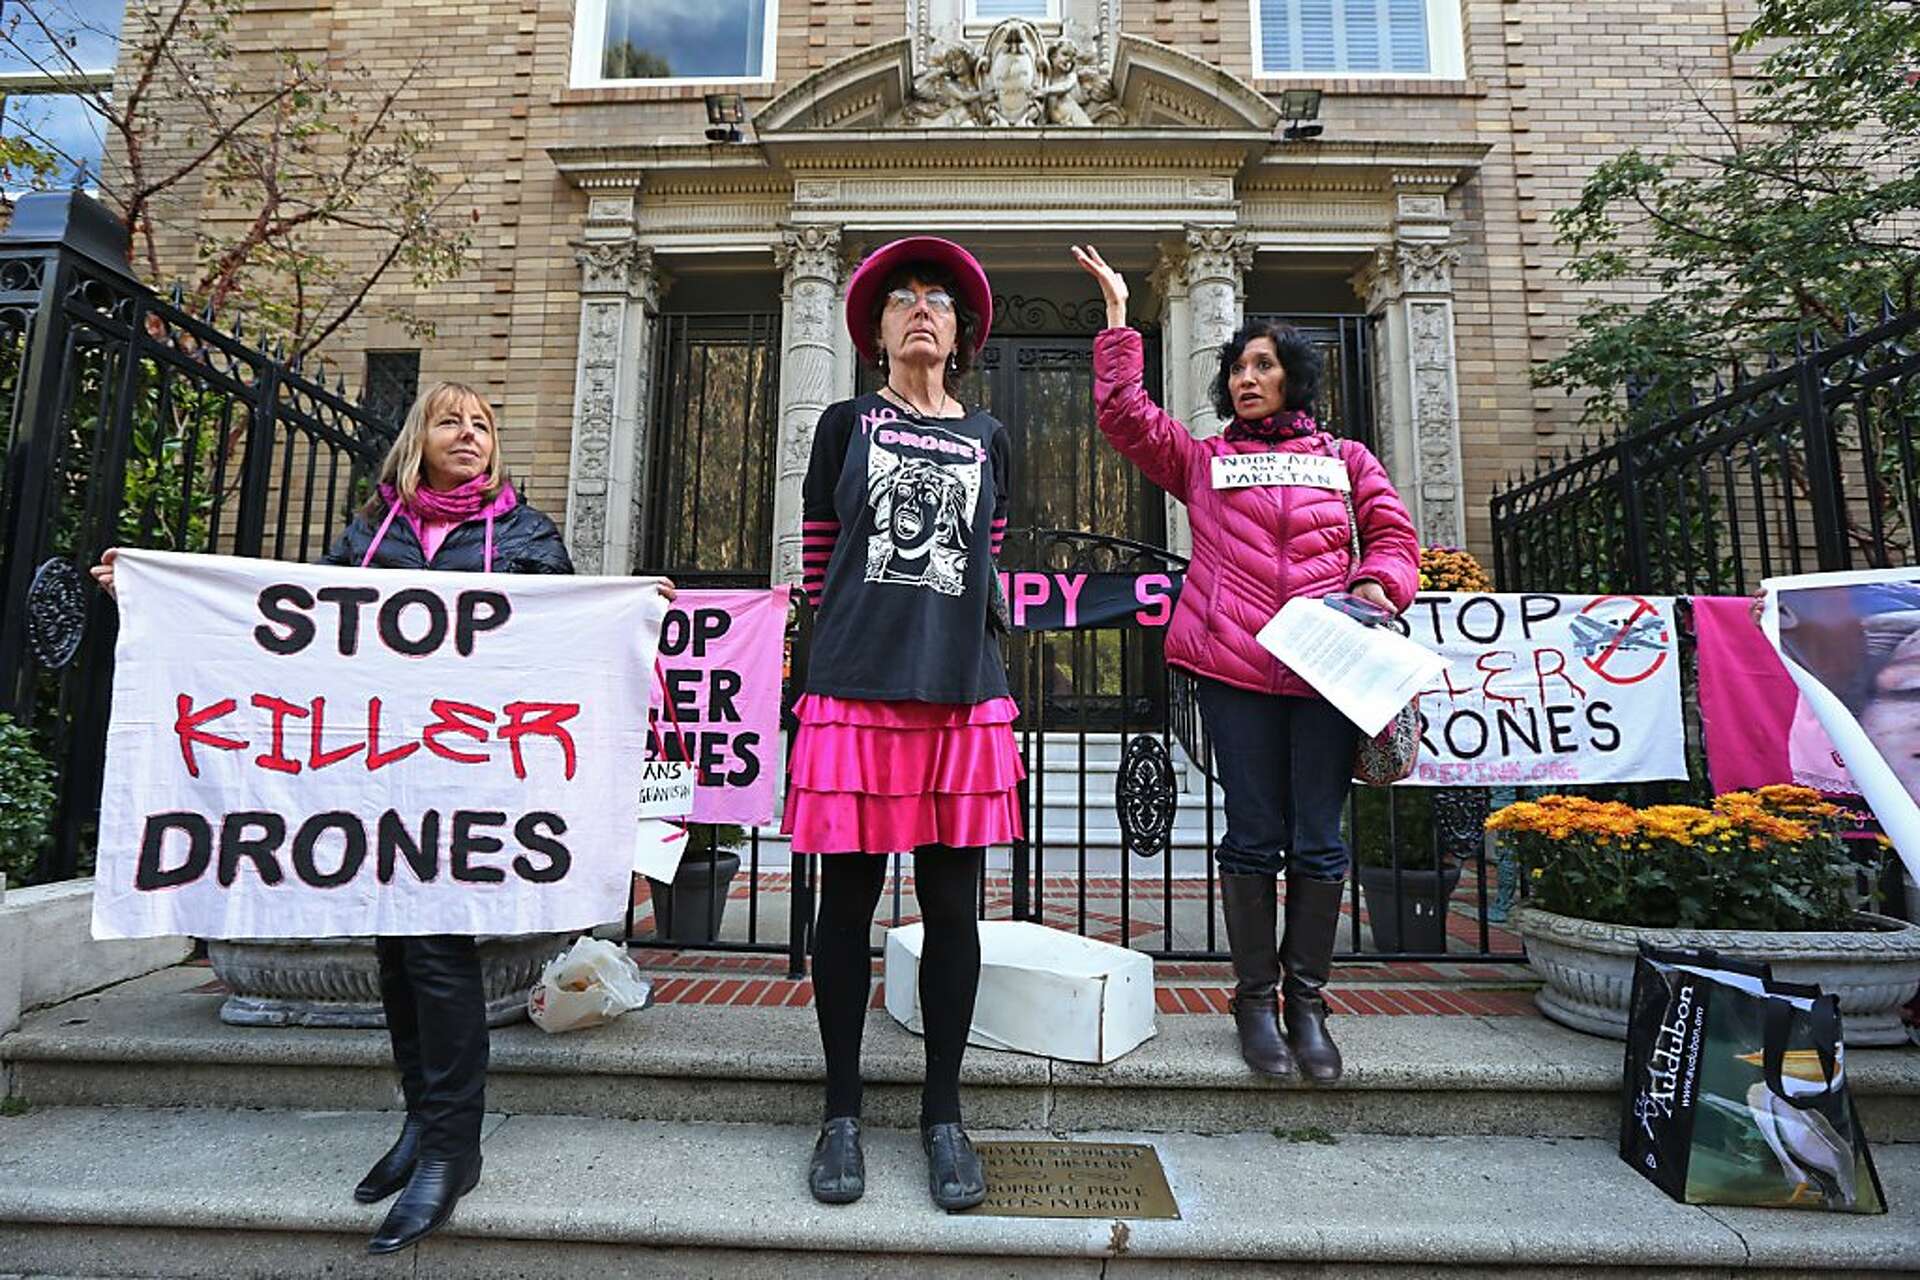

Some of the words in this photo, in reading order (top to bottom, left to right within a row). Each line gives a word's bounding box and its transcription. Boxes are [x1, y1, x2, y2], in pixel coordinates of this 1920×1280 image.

[861, 407, 897, 435] NO
[879, 429, 987, 463] DRONES
[1221, 454, 1277, 467] NOOR
[1226, 472, 1330, 485] PAKISTAN
[253, 583, 512, 659] STOP
[999, 572, 1088, 627] PY
[1135, 573, 1187, 627] S
[658, 608, 732, 658] OP
[649, 669, 742, 723] ER
[174, 692, 580, 780] KILLER
[1420, 701, 1621, 759] RONES
[645, 730, 760, 787] NES
[1418, 760, 1580, 784] DEPINK.ORG
[134, 808, 572, 891] DRONES
[1650, 985, 1695, 1119] Audubon
[976, 1146, 1036, 1156] RIVATE
